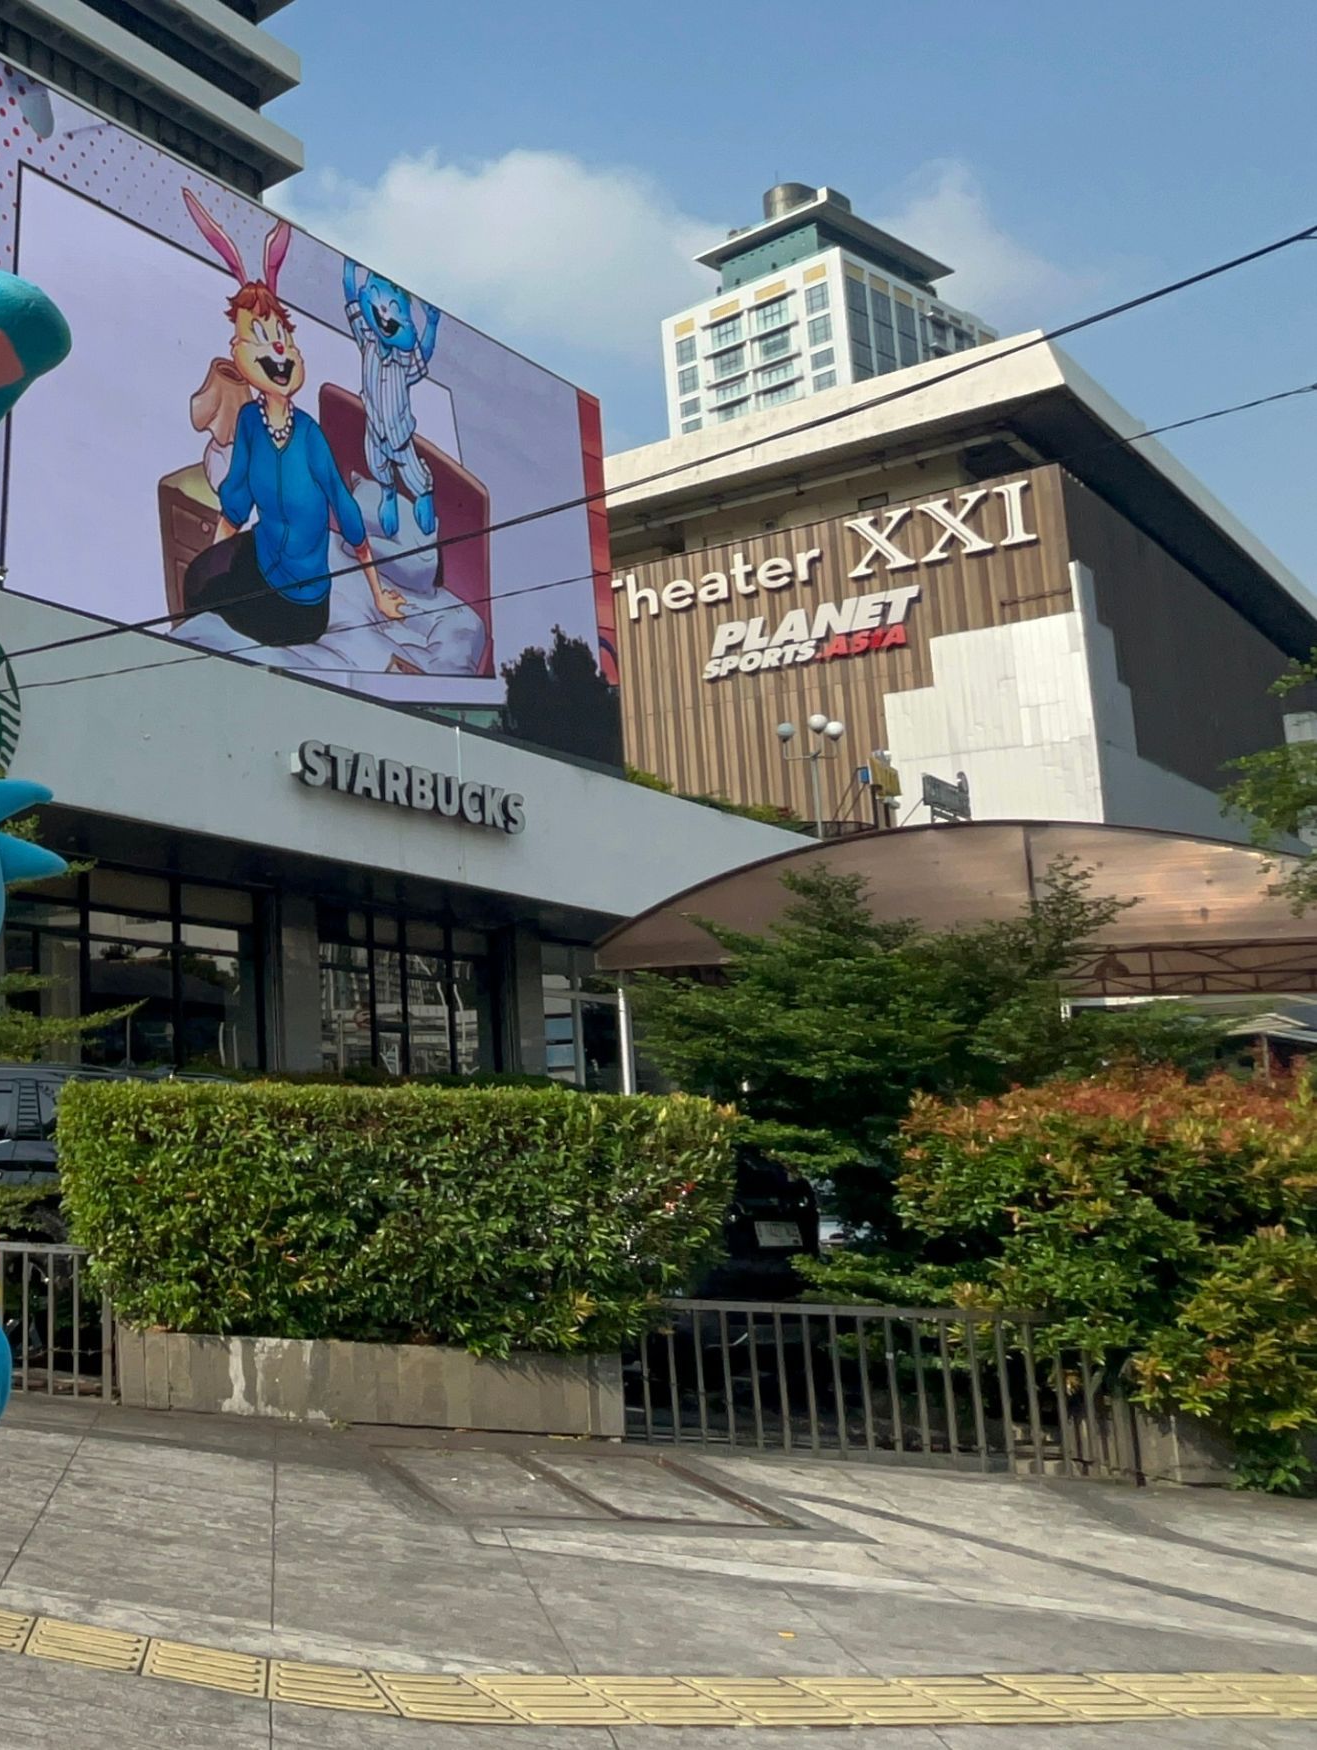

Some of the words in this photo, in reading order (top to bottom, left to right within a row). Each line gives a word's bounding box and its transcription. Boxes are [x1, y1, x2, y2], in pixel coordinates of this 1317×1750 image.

[611, 548, 822, 620] heater
[843, 480, 1039, 579] XXI
[711, 584, 921, 657] PLANET
[298, 739, 526, 834] STARBUCKS
